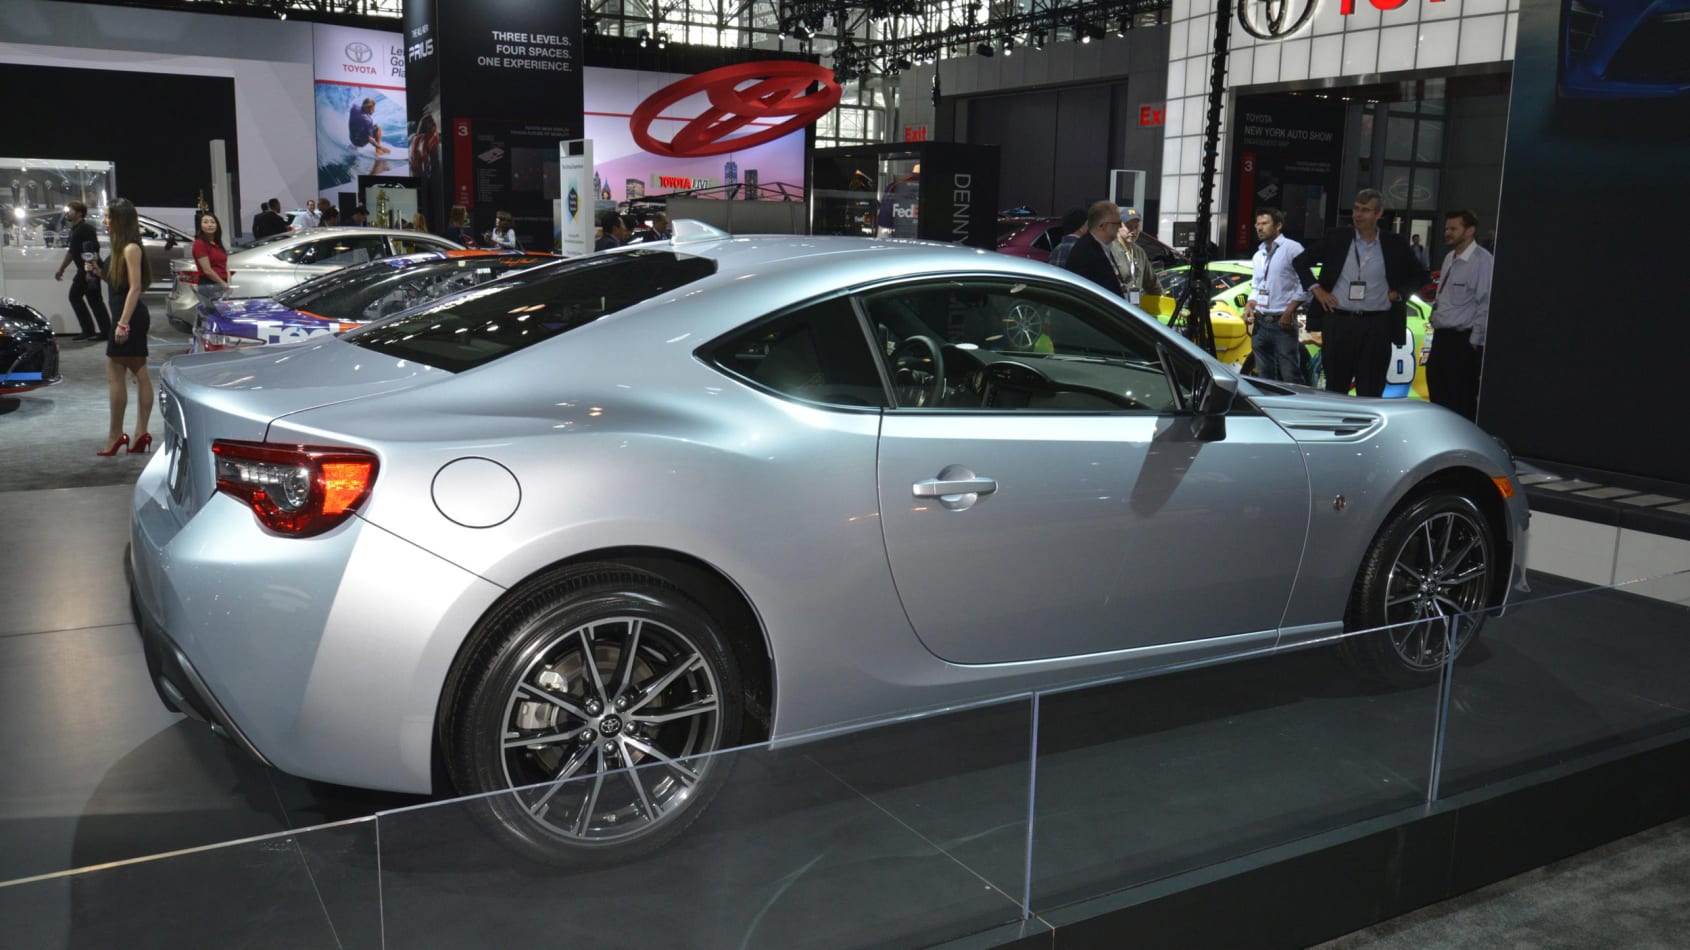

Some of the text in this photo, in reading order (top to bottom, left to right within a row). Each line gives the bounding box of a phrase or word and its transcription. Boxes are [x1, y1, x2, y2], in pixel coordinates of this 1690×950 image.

[491, 31, 572, 46] THREE LEVELS.
[408, 38, 434, 64] PRIUS
[496, 44, 572, 59] FOUR SPACES.
[391, 56, 404, 67] Go
[477, 56, 572, 72] ONE EXPERIENCE.
[342, 64, 376, 75] TOYOTA
[1246, 113, 1272, 123] TOYOTA
[457, 125, 469, 137] 3
[904, 126, 927, 143] Exit
[1245, 126, 1333, 143] NEW YORK AUTO SHOW
[1244, 160, 1254, 172] 3
[659, 175, 692, 189] TOYOTA
[951, 173, 972, 245] DENNY
[257, 320, 352, 345] Fed
